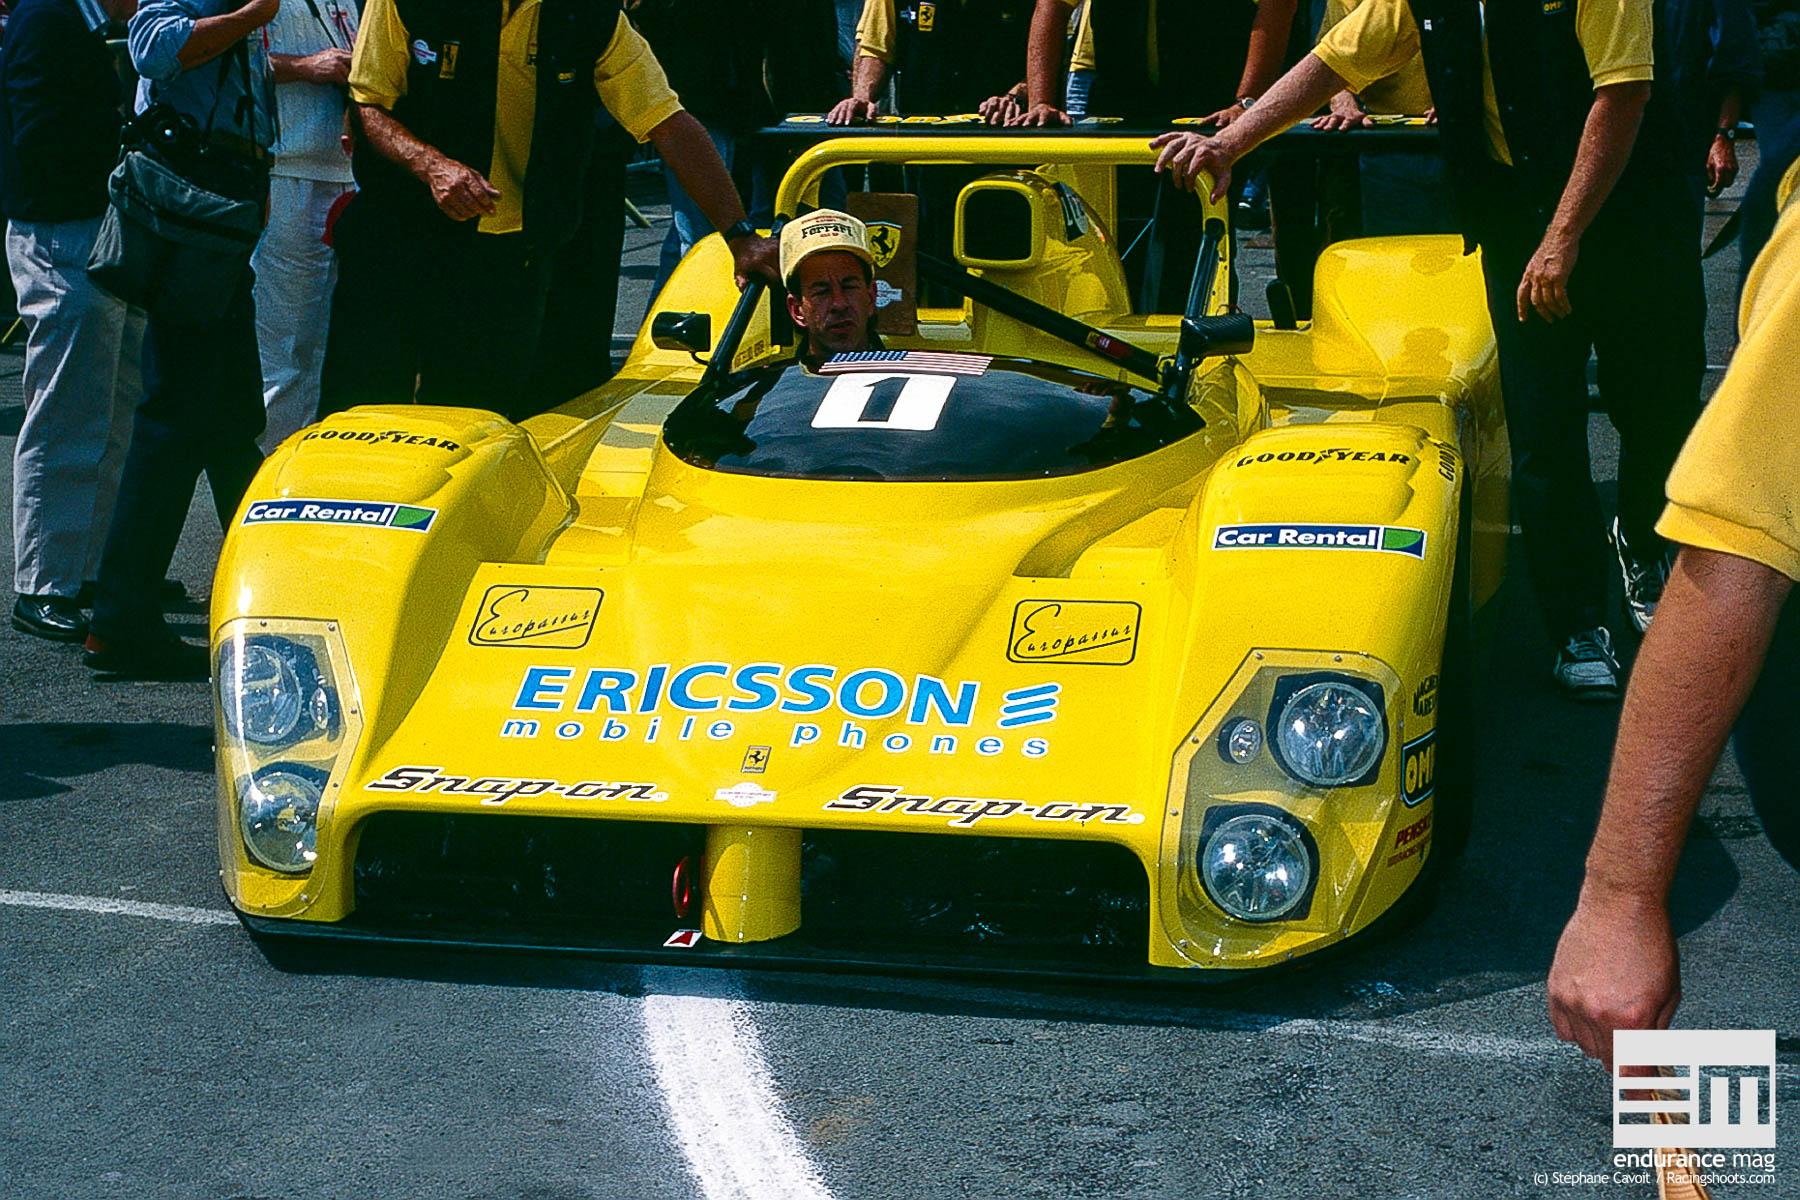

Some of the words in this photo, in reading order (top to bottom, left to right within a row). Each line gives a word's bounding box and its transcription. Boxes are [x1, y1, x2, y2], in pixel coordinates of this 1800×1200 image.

[858, 376, 911, 422] 1
[302, 430, 460, 452] GOODYEAR
[1236, 448, 1410, 468] GOODYEAR
[249, 505, 297, 520] Car
[299, 505, 391, 523] Rental
[1218, 529, 1273, 546] Car
[1278, 528, 1377, 546] Rental
[511, 664, 978, 726] ERICSSON
[503, 716, 733, 741] mobile
[792, 722, 1049, 756] phones
[367, 767, 655, 803] Snap-on
[826, 787, 1129, 824] Snap-on
